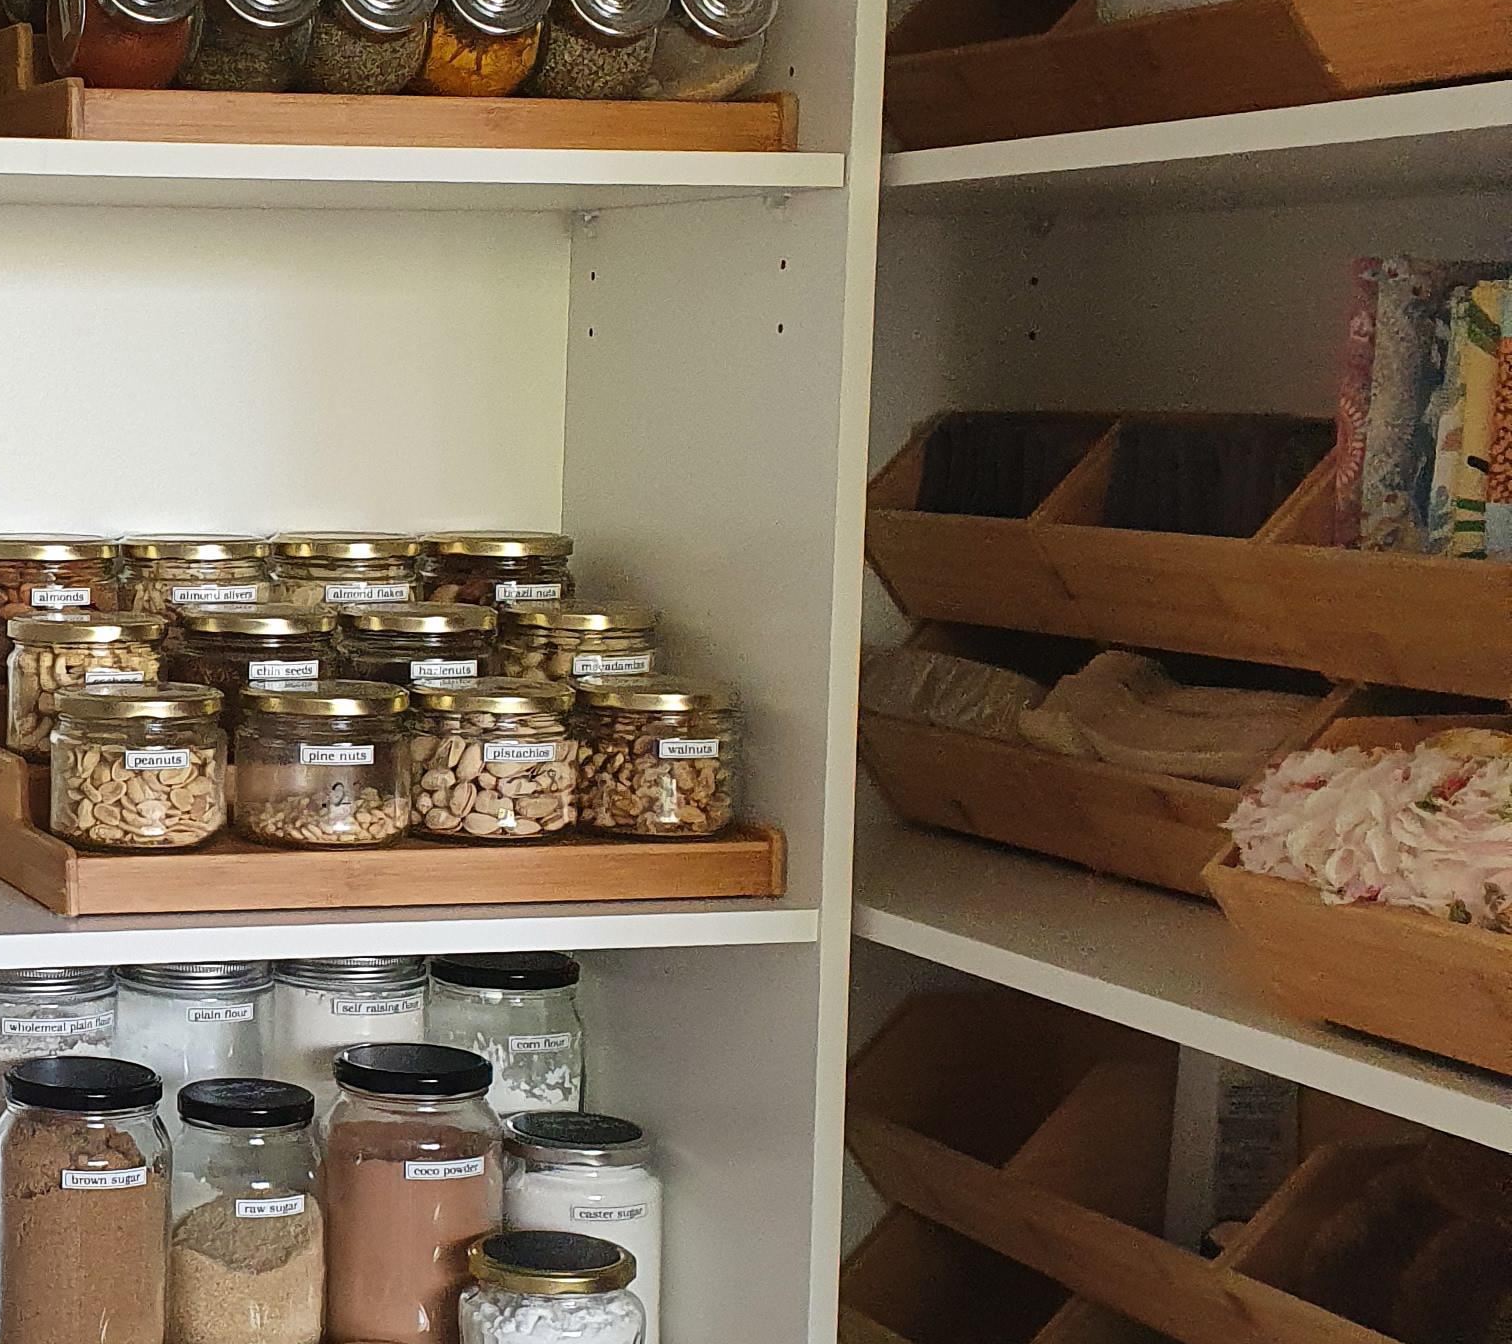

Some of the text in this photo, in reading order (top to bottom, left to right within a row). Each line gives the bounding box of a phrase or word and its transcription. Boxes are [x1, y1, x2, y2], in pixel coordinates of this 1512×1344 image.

[38, 591, 85, 603] almonds
[332, 587, 405, 600] almond flakes
[581, 659, 645, 673] macadamias
[308, 749, 367, 763] pine nuts
[493, 746, 550, 760] pistachios
[668, 743, 714, 756] walnuts
[133, 754, 182, 768] peanuts
[194, 1006, 248, 1022] plain flour
[342, 999, 420, 1015] self raising flour
[516, 1036, 567, 1049] corn flour
[414, 1162, 480, 1179] coco powder
[71, 1172, 142, 1188] brown sugar
[244, 1202, 299, 1218] raw sugar
[578, 1206, 643, 1222] caster sugar
